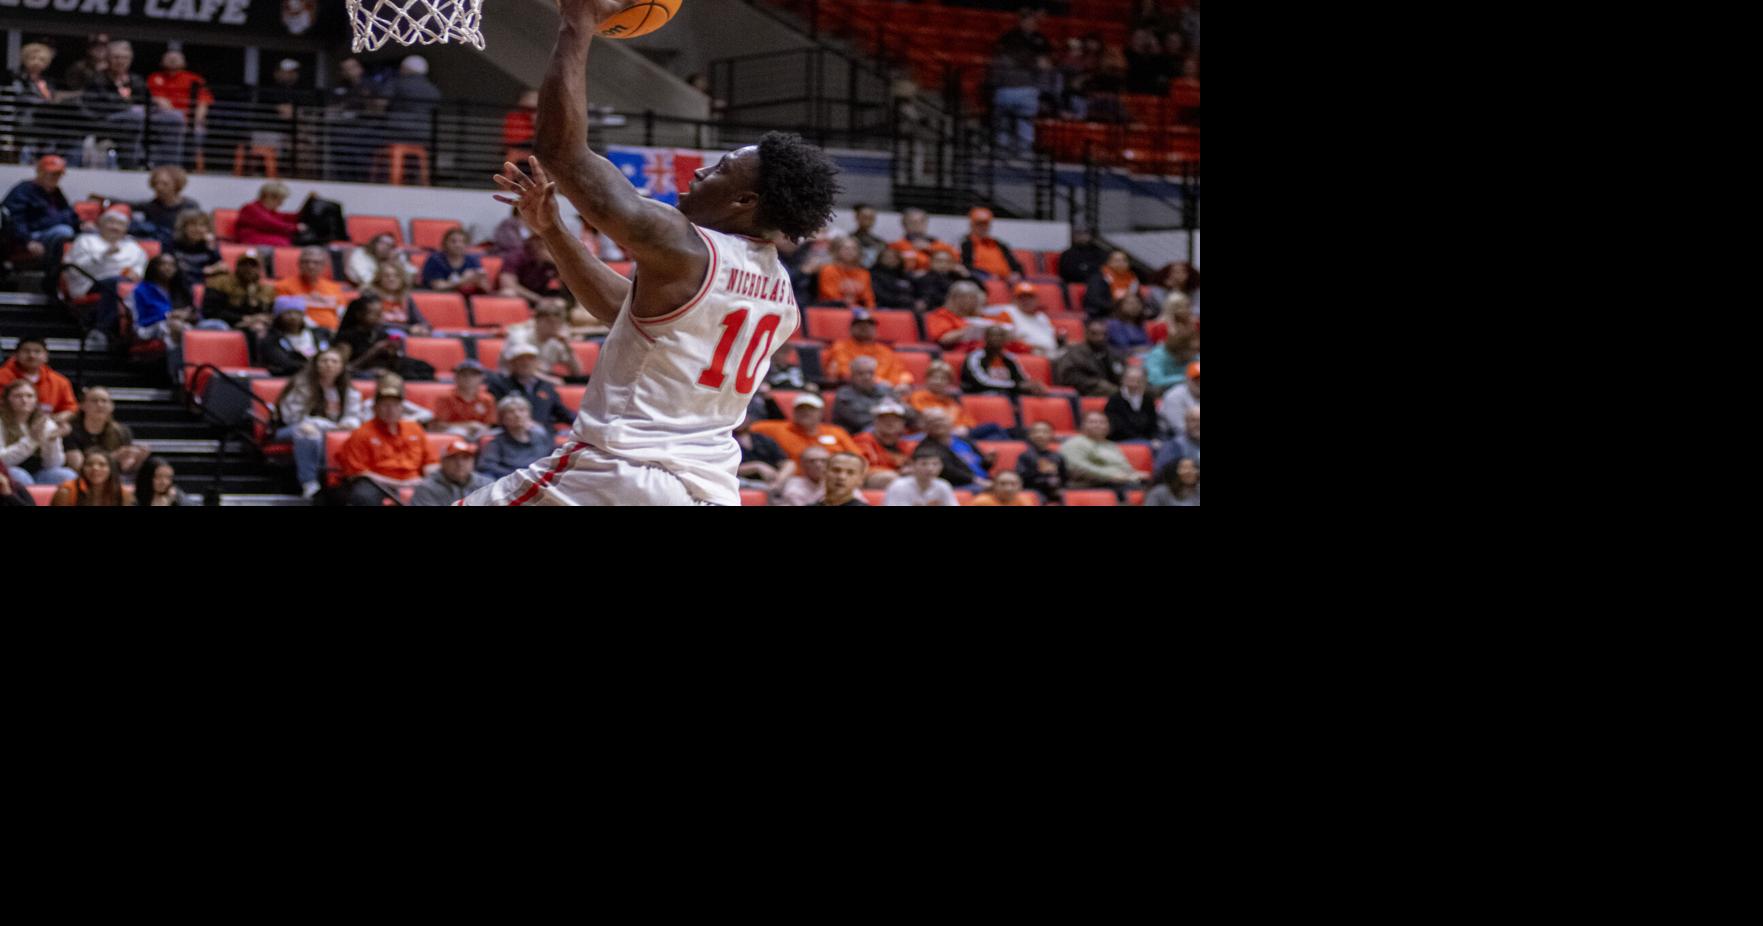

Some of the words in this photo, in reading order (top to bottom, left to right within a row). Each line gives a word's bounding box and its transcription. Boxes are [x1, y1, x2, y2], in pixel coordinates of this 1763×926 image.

[144, 0, 250, 24] CAFE
[727, 267, 786, 303] NICHOLAS
[698, 307, 781, 394] 10
